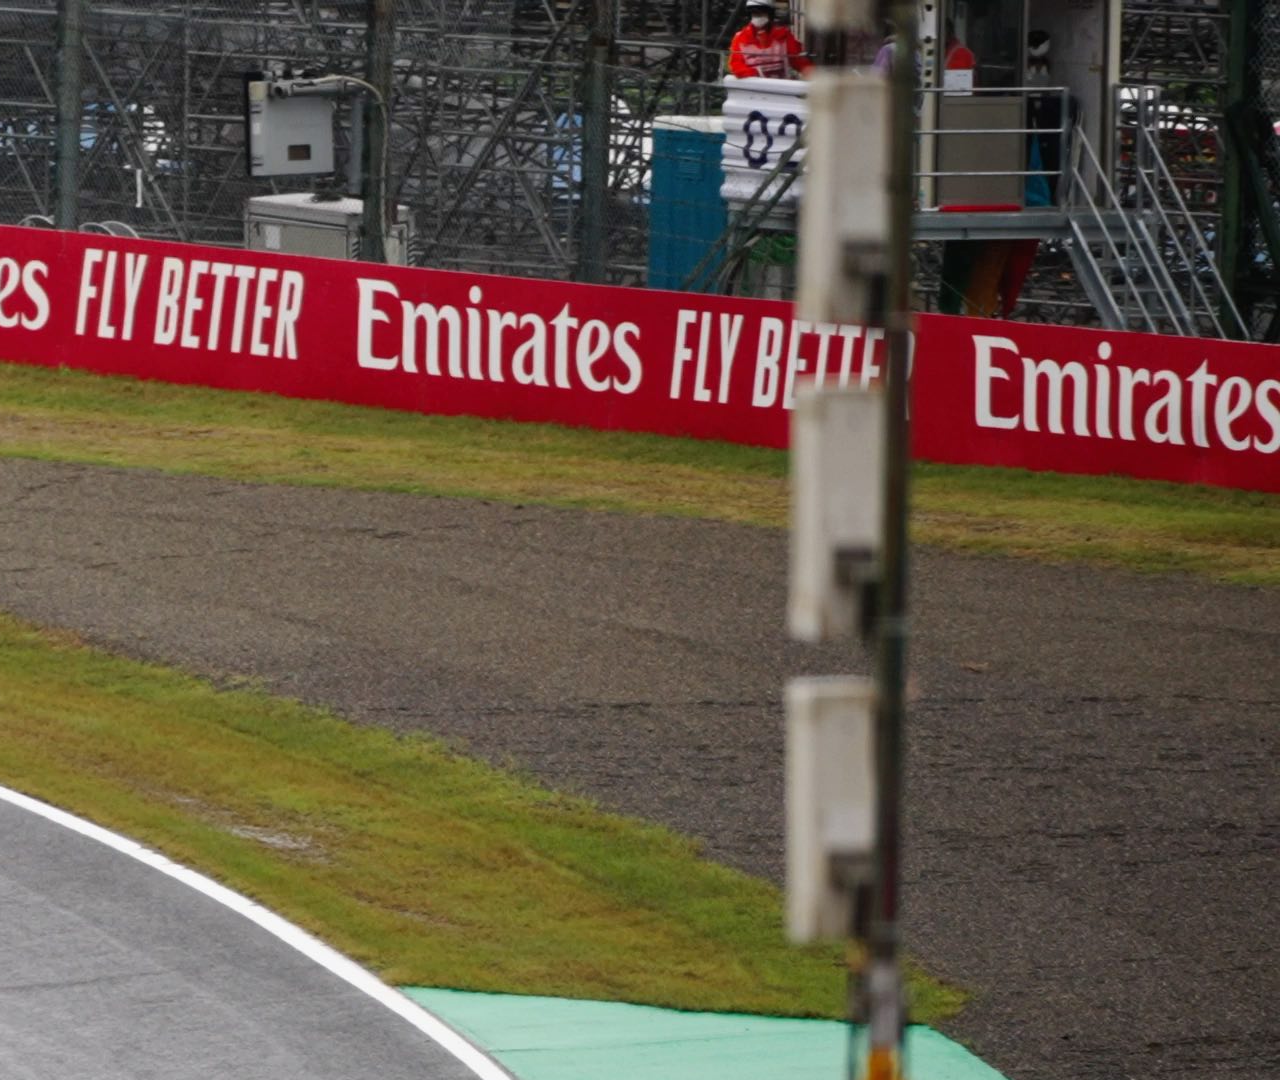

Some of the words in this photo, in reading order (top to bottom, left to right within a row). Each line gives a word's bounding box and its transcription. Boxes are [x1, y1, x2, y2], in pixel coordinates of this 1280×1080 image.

[76, 247, 149, 341] FLY
[154, 256, 305, 360] BETTER
[355, 277, 643, 394] Emirates
[670, 309, 744, 404] FLY
[752, 316, 916, 421] BETTE
[971, 334, 1280, 454] Emirates
